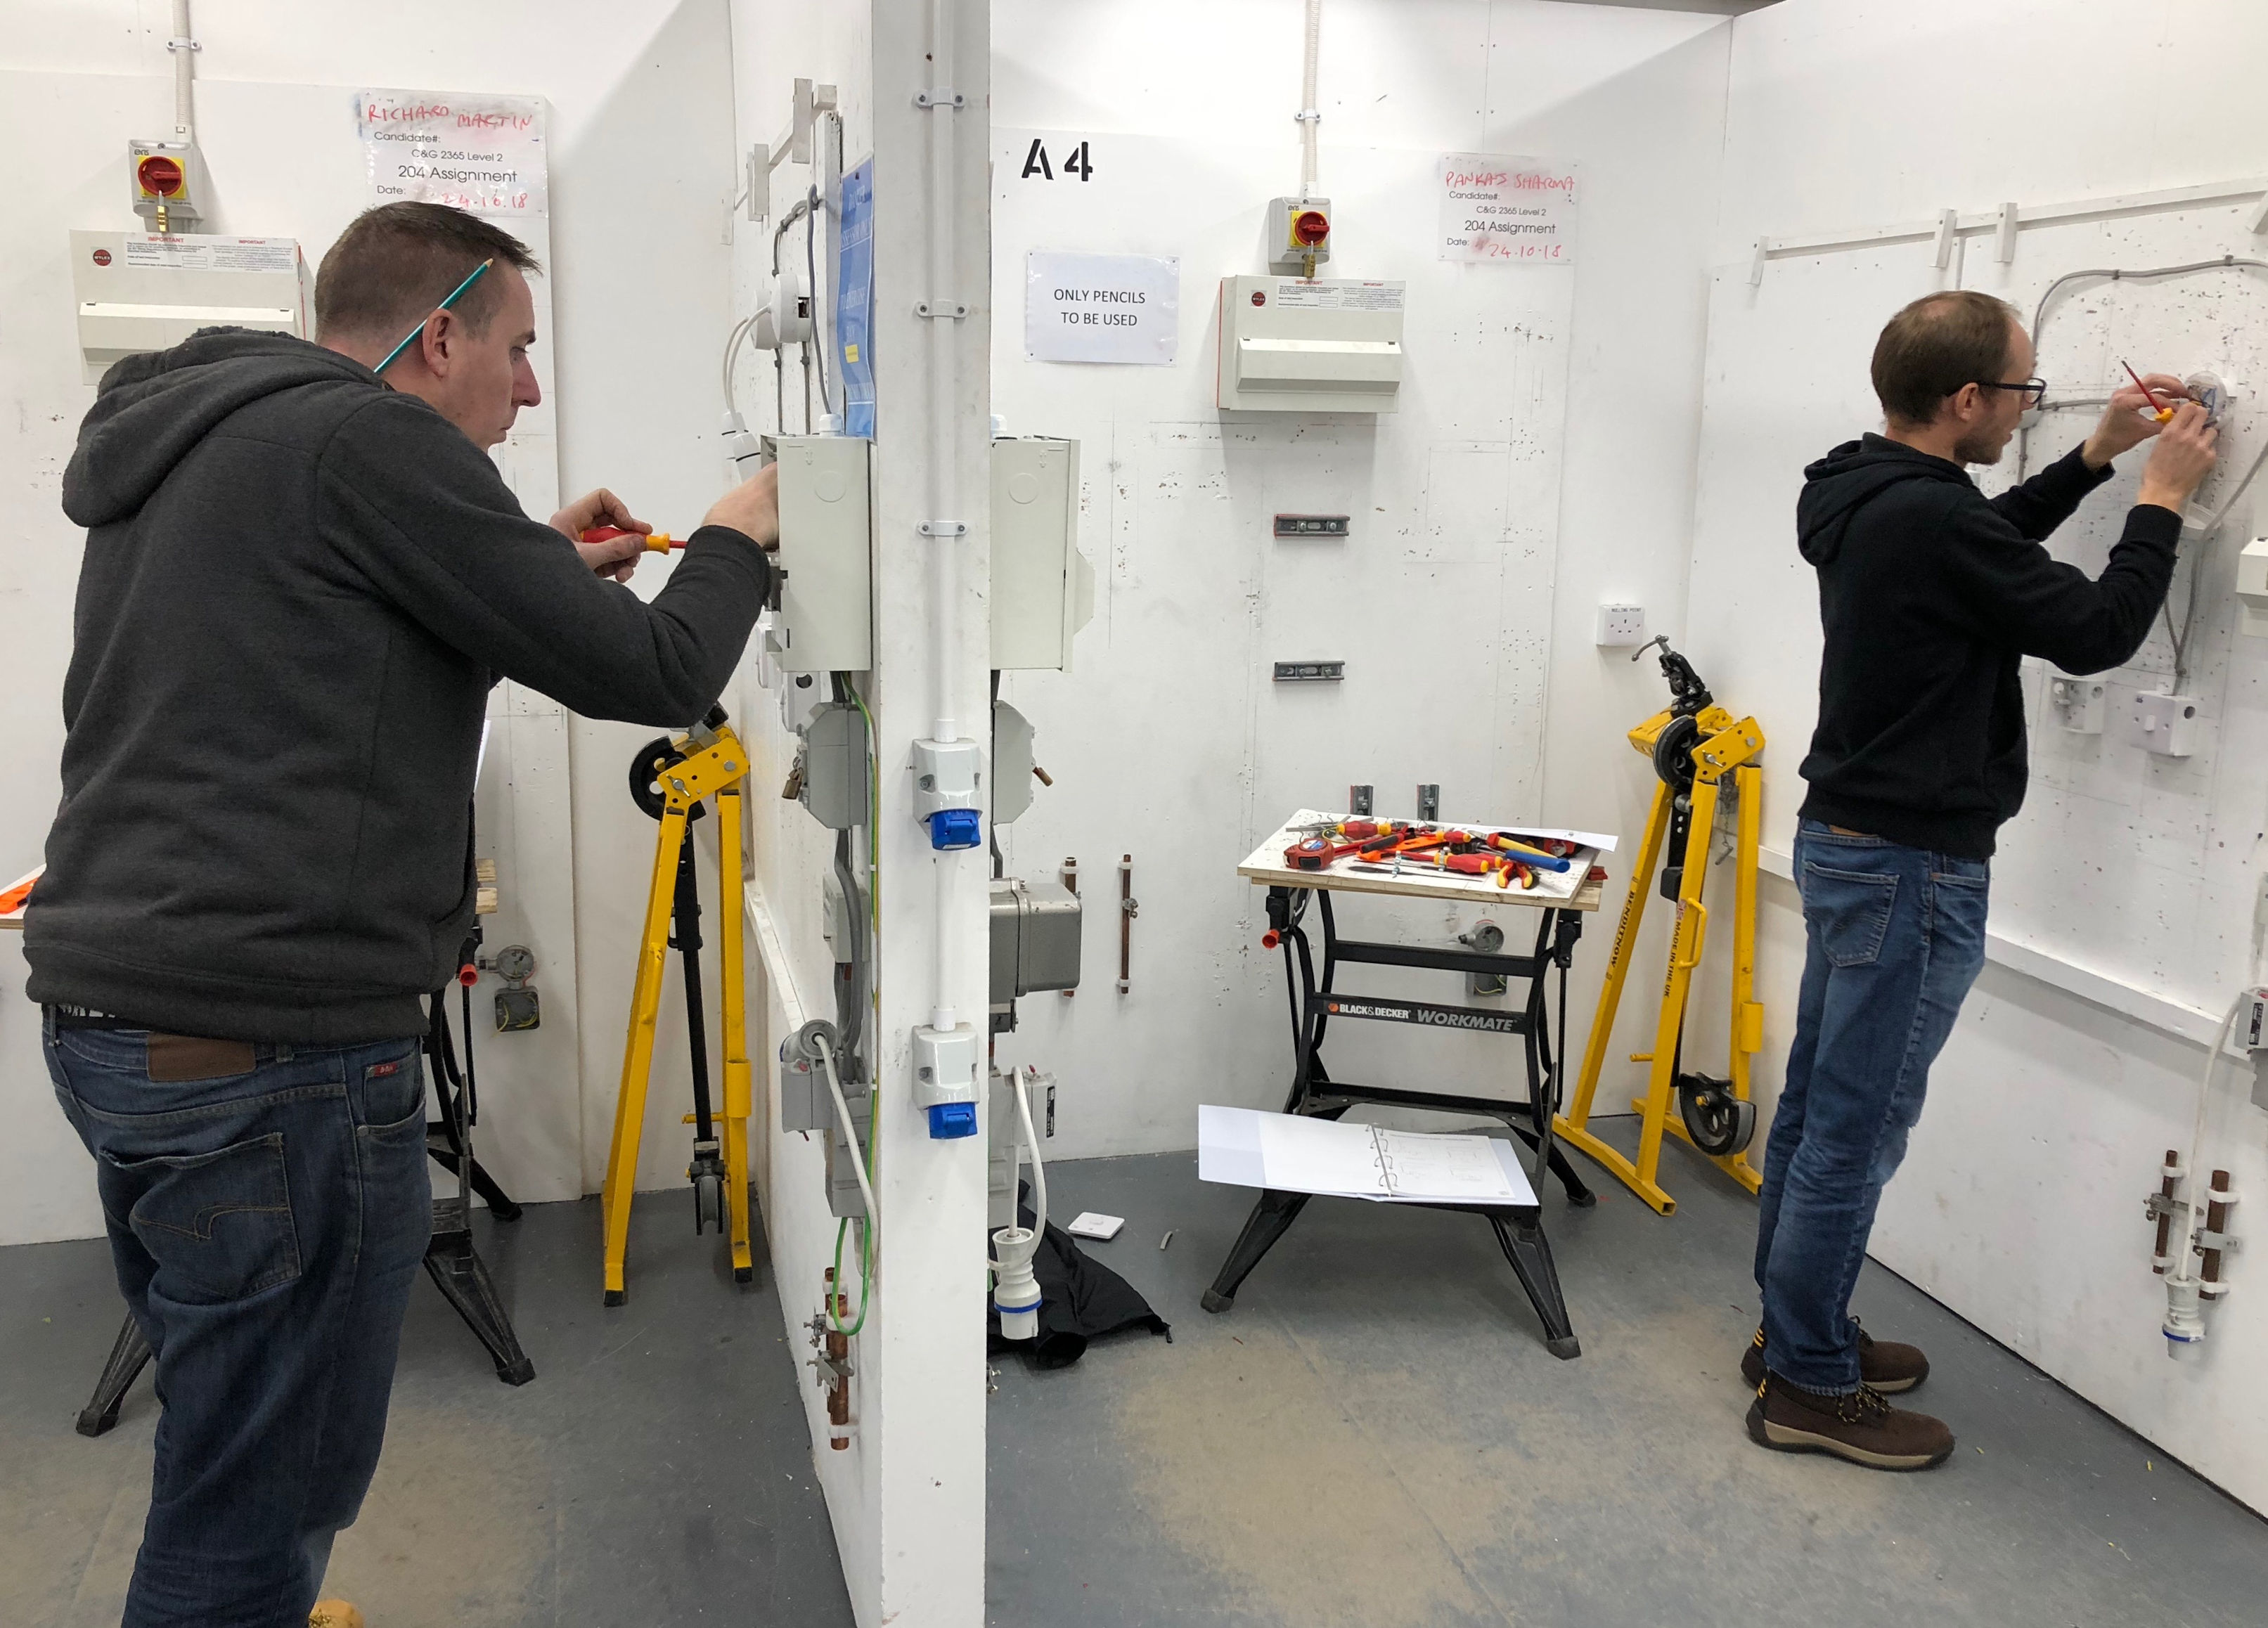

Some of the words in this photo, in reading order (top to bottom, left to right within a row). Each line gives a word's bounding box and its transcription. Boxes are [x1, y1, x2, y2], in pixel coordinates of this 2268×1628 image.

[368, 104, 449, 123] RICHARD
[457, 114, 532, 131] MARTIN
[374, 131, 441, 143] Candidate#:
[411, 149, 438, 158] C&G
[440, 150, 465, 160] 2365
[468, 152, 494, 162] Level
[496, 153, 503, 162] 2
[398, 165, 425, 179] 204
[430, 167, 517, 183] Assignment
[1445, 171, 1507, 188] PANKAJ
[1514, 174, 1575, 191] SHARMA
[377, 186, 406, 195] Date:
[1449, 190, 1500, 200] Candidate#:
[1476, 206, 1497, 214] C&G
[1498, 207, 1517, 215] 2365
[1519, 207, 1539, 216] Level
[1464, 220, 1486, 231] 204
[1488, 221, 1556, 235] Assignment
[1447, 238, 1469, 246] Date:
[1054, 289, 1090, 302] ONLY
[1093, 290, 1145, 304] PENCILS
[1061, 312, 1079, 325] TO
[1083, 314, 1099, 325] BE
[1104, 314, 1138, 326] USED
[1673, 922, 1681, 949] MADE
[1670, 952, 1676, 963] IN
[1664, 985, 1671, 998] UK
[1417, 1008, 1514, 1031] WORKMATE
